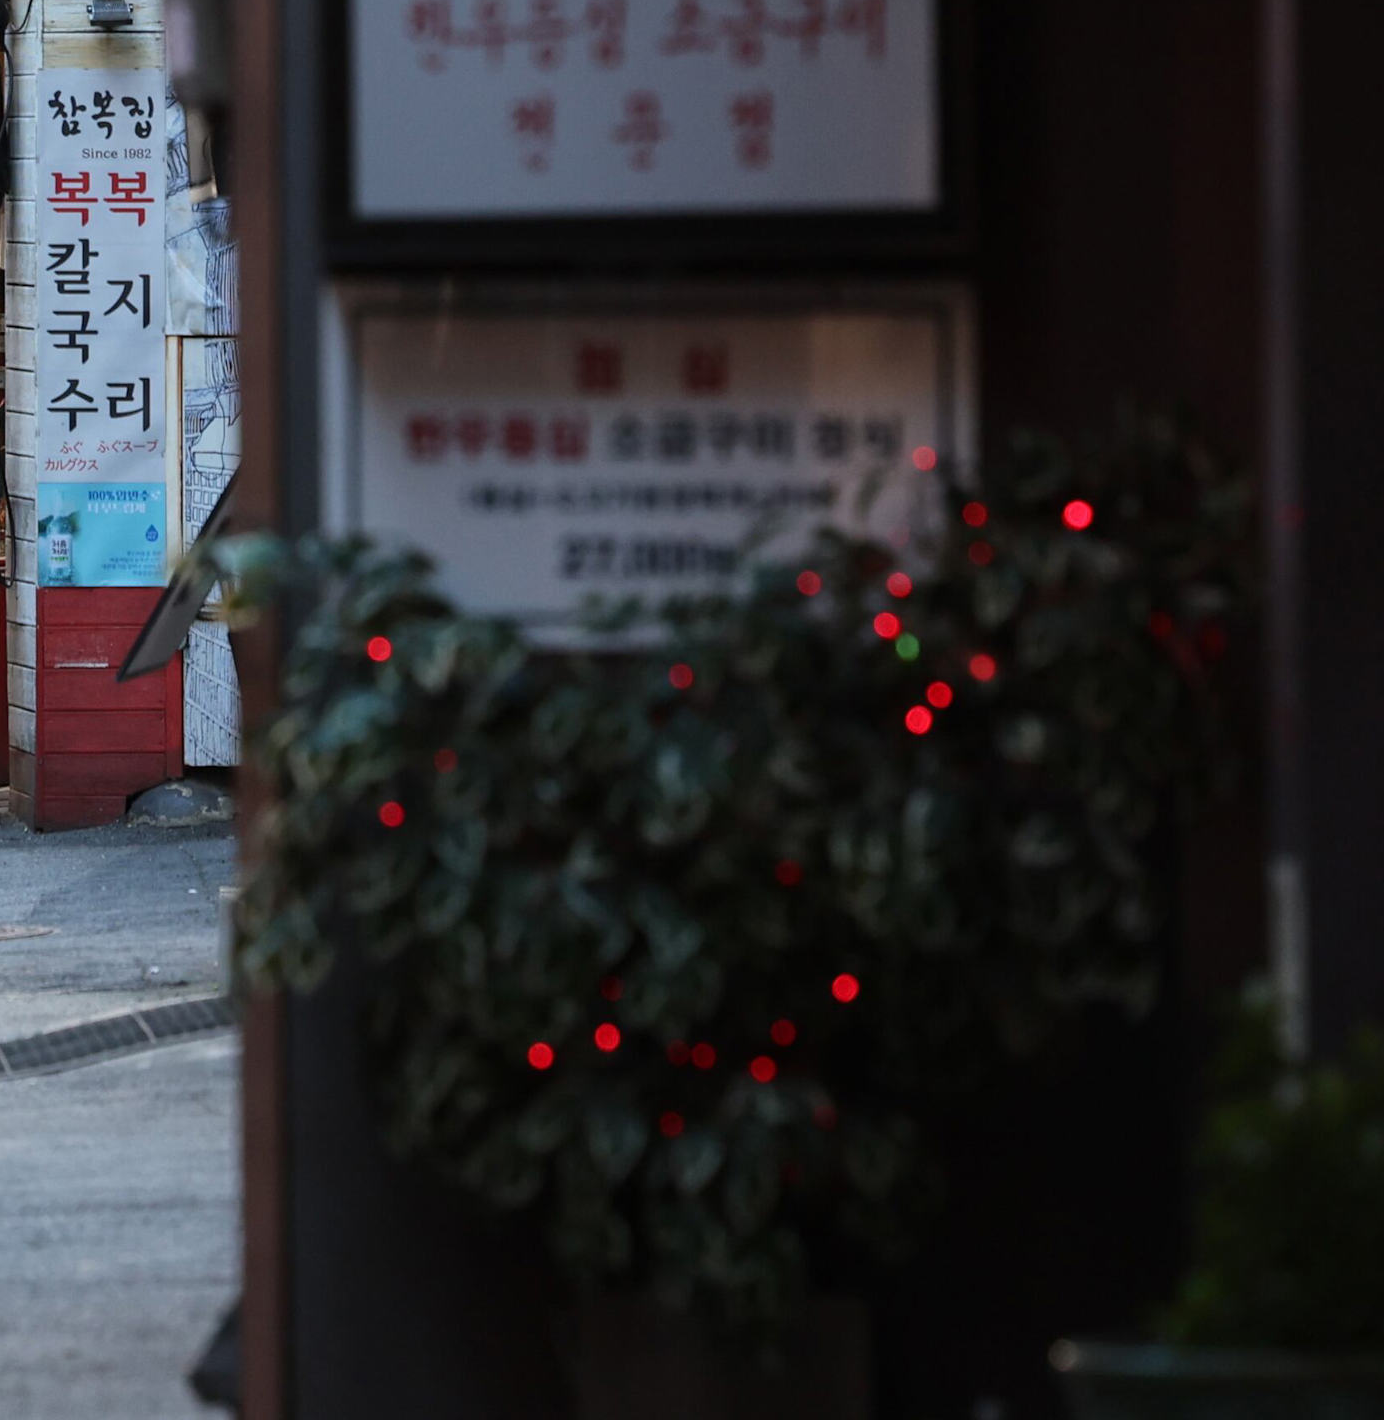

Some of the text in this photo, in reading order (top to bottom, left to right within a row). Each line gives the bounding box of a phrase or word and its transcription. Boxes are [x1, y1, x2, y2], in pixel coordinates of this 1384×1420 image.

[48, 90, 154, 141] 참복집
[82, 148, 153, 160] Since 1982
[59, 440, 84, 455] ふぐ
